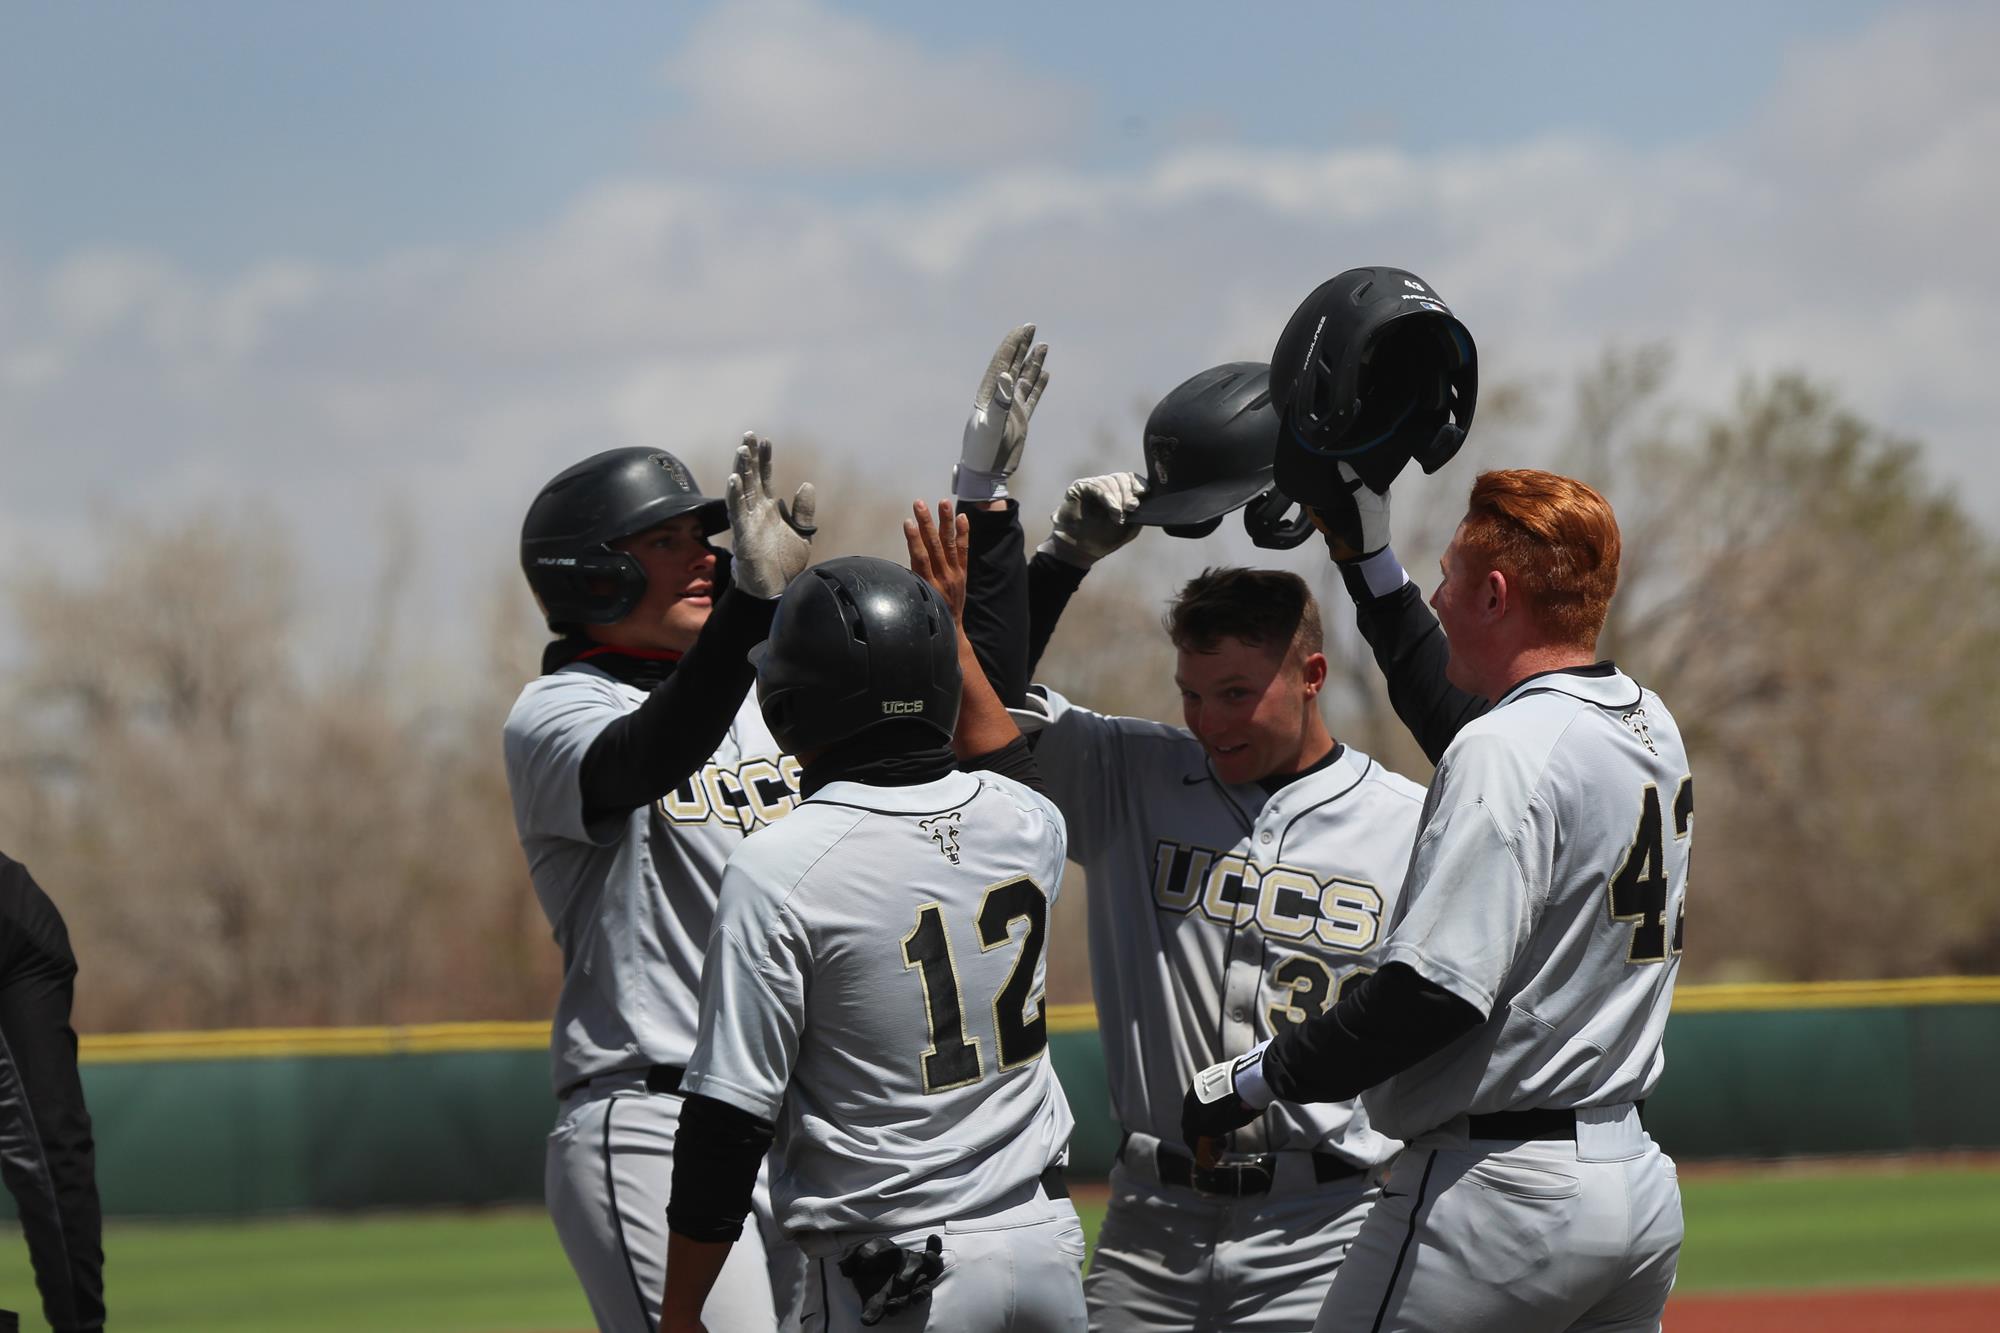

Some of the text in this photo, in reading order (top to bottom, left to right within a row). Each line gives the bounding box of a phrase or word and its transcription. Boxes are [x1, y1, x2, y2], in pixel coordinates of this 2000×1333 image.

[881, 700, 924, 714] UCCS
[1152, 839, 1385, 956] UCCS
[899, 872, 1048, 1095] 12
[1265, 953, 1377, 1038] 3
